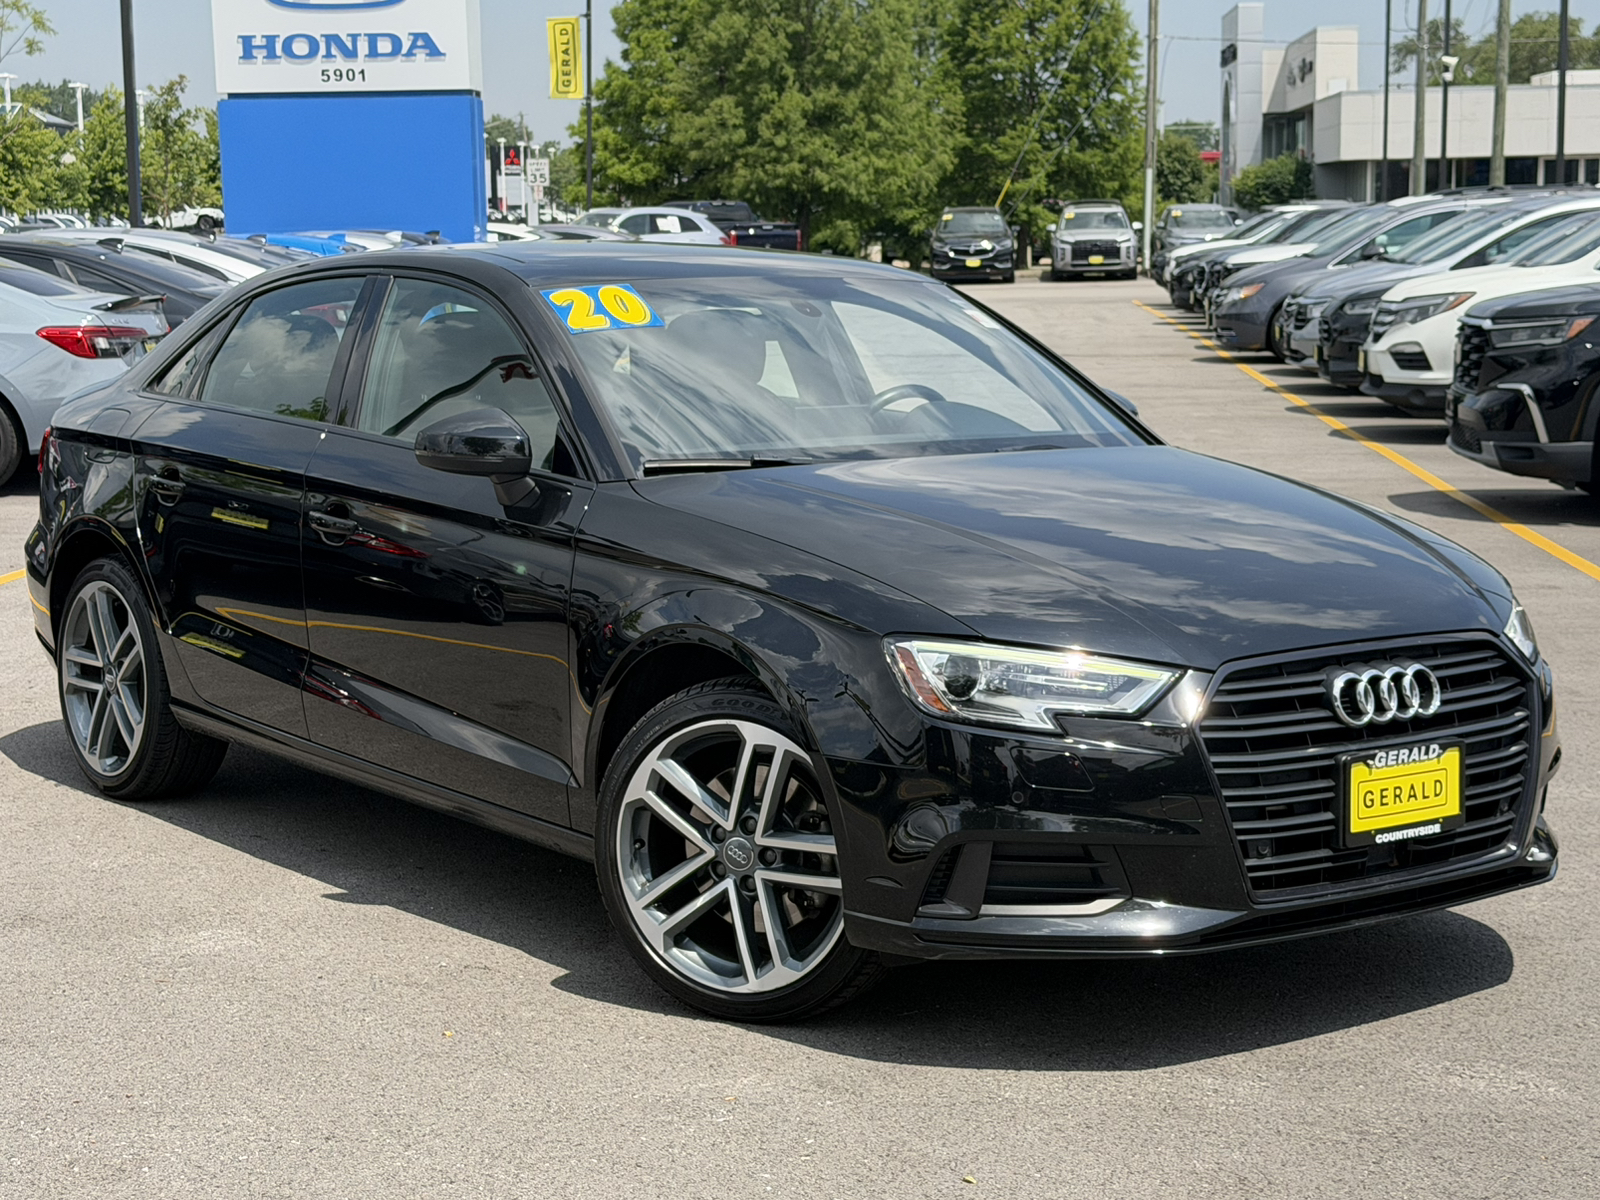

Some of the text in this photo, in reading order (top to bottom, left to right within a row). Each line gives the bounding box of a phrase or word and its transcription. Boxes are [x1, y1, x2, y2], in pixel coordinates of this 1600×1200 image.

[237, 32, 447, 62] HONDA
[559, 27, 572, 88] GERALD
[320, 68, 366, 83] 5901
[529, 173, 547, 184] 35
[548, 287, 651, 330] 20
[1374, 743, 1440, 768] GERALD
[1363, 779, 1444, 809] GERALD
[1375, 823, 1442, 844] COUNTRYSIDE
